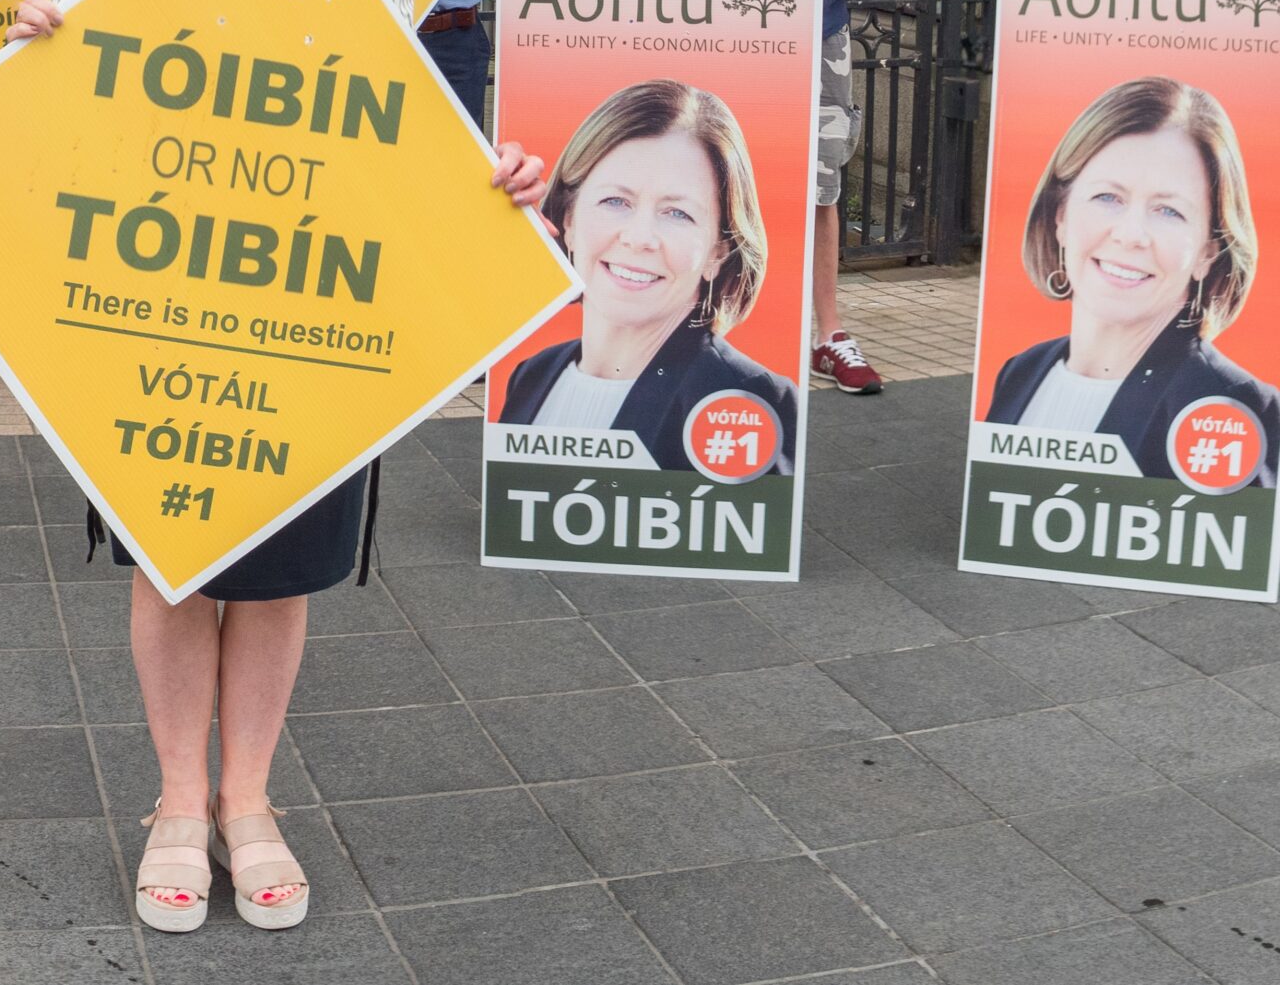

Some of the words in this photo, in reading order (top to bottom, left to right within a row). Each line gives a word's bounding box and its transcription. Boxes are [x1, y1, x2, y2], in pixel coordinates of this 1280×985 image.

[517, 34, 550, 48] LIFE
[566, 34, 617, 49] UNITY
[633, 36, 725, 53] ECONOMIC
[729, 39, 797, 55] JUSTICE
[1015, 29, 1048, 44] LIFE
[1063, 31, 1113, 46] UNITY
[1128, 34, 1218, 51] ECONOMIC
[1222, 38, 1280, 54] JUSTIC
[82, 28, 406, 146] TÓIBÍN
[152, 136, 216, 186] OR
[230, 147, 325, 201] NOT
[55, 190, 382, 304] TÓIBÍN
[63, 281, 152, 327] There
[162, 298, 189, 326] is
[200, 310, 240, 334] no
[249, 317, 395, 356] question!
[139, 363, 279, 414] VÓTÁIL
[707, 409, 763, 426] VÓTÁIL
[1191, 417, 1248, 436] VÓTÁIL
[113, 417, 291, 476] TÓÍBÍN
[506, 432, 634, 460] MAIREAD
[705, 430, 759, 466] #1
[990, 432, 1118, 465] MAIREAD
[1187, 438, 1243, 477] #1
[161, 482, 215, 521] #1
[507, 478, 766, 554] TÓIBÍN
[989, 482, 1247, 571] TÓIBÍN
